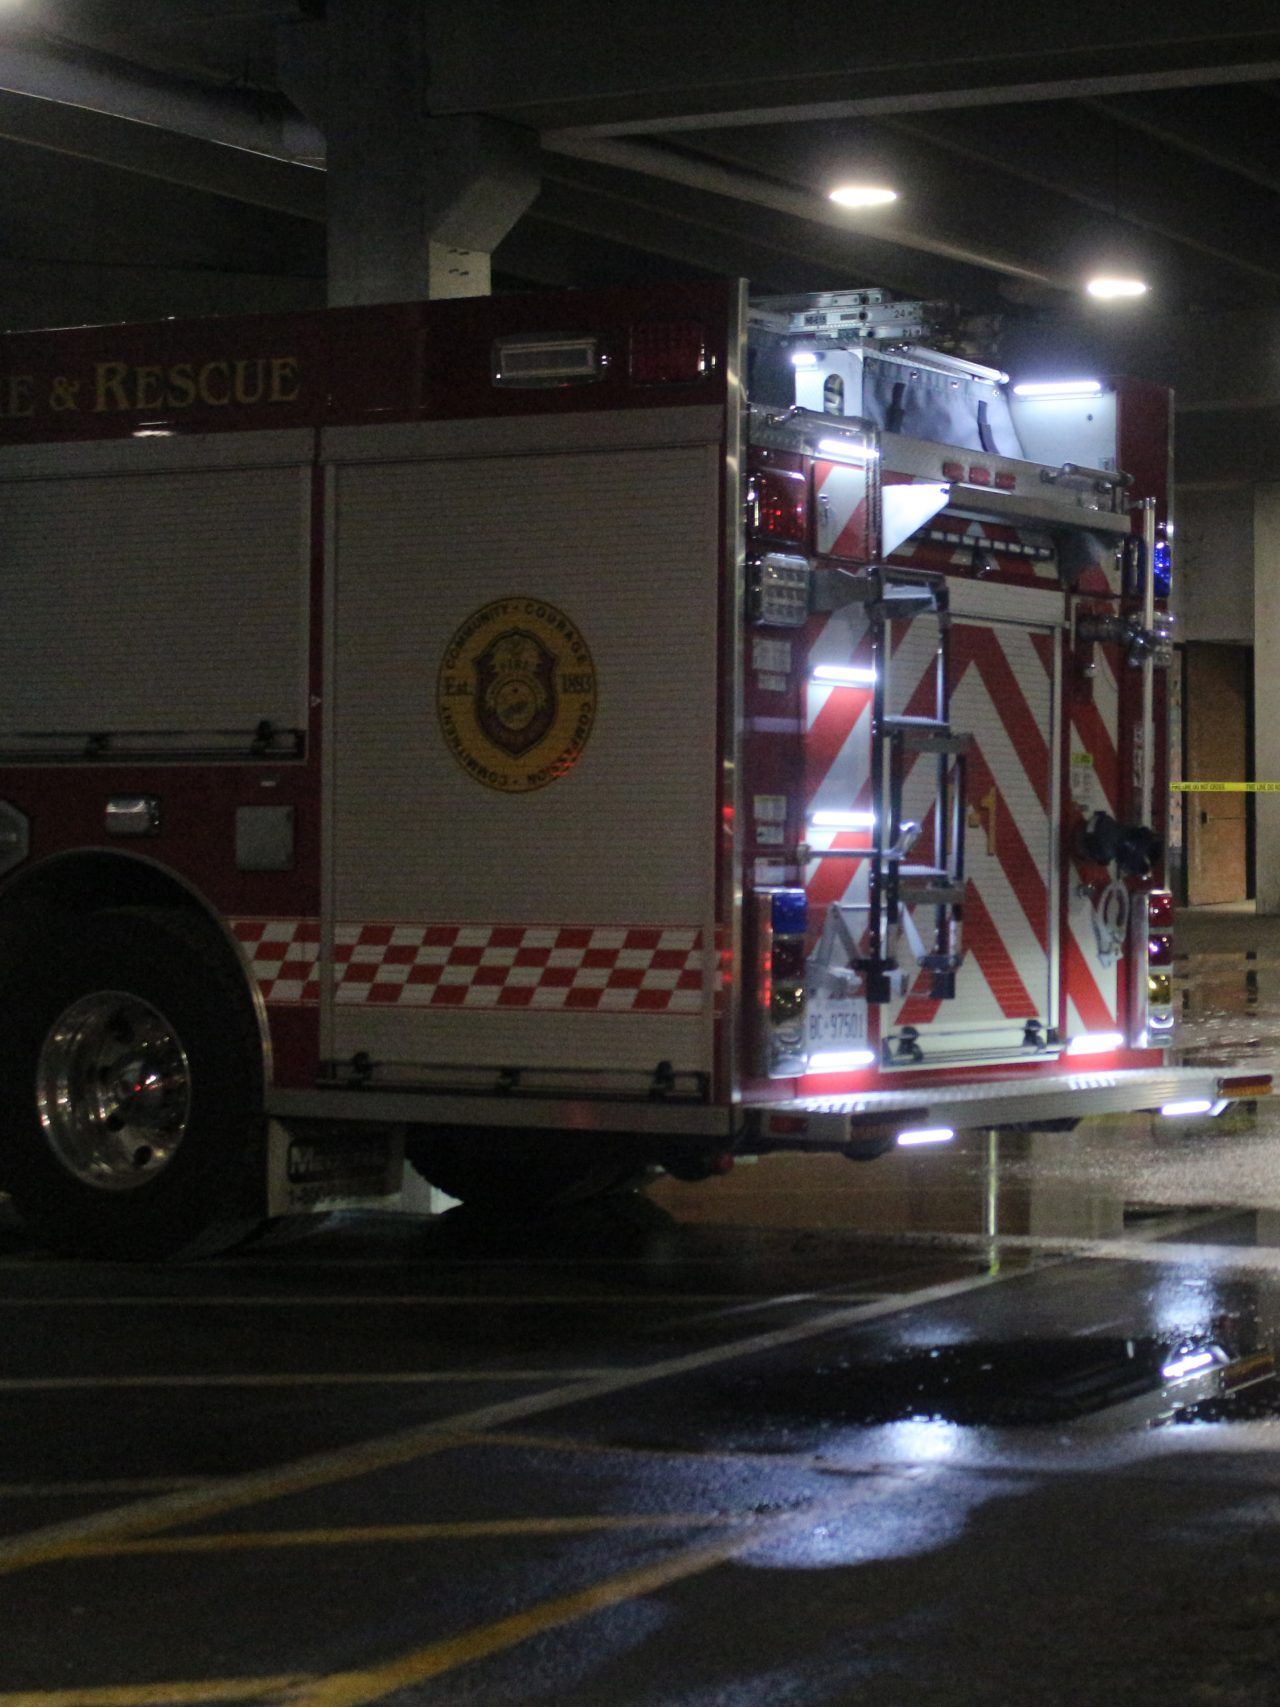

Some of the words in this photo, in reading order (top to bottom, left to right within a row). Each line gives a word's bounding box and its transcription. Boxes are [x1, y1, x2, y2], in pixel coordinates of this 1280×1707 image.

[50, 376, 80, 411] &
[93, 356, 300, 412] RESCUE
[524, 603, 587, 663] COURAGE
